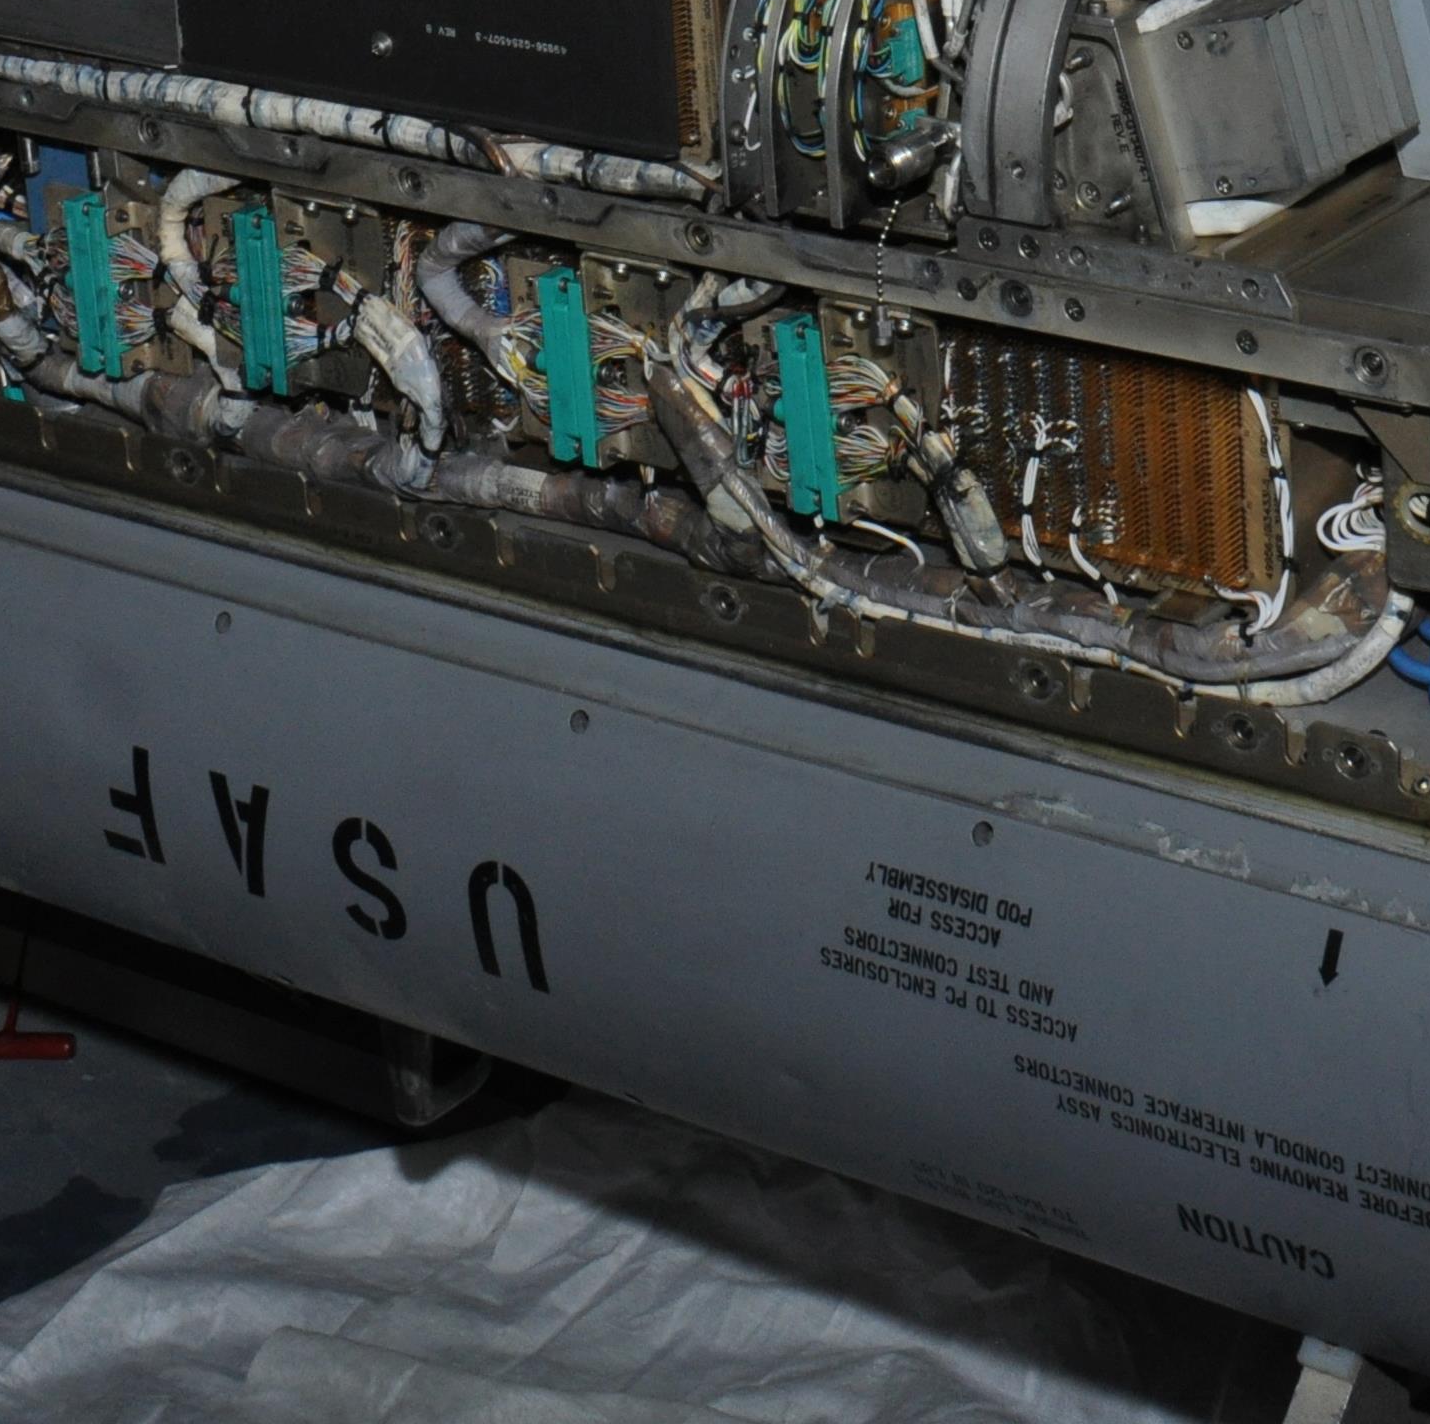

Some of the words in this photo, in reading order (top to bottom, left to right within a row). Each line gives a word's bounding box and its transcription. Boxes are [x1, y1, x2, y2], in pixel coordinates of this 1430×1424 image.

[864, 860, 989, 915] DISASSEMBLY
[886, 896, 922, 926] FOR
[930, 910, 1002, 949] ACCESS
[996, 899, 1033, 929] POD
[819, 946, 936, 999] ENCLOSURES
[843, 925, 958, 978] CONNECTORS
[945, 985, 968, 1010] PC
[966, 963, 1009, 995] TEST
[1018, 979, 1055, 1007] AND
[975, 995, 997, 1020] TO
[1006, 1004, 1078, 1043] ACCESS
[1013, 1053, 1134, 1108] CONNECTORS
[1055, 1093, 1102, 1124] ASSY
[1143, 1093, 1245, 1144] INTERFACE
[1110, 1109, 1241, 1168] ELECTRONICS
[1254, 1129, 1346, 1175] GONDOLA
[1249, 1155, 1349, 1204] REMOVING
[1176, 1202, 1336, 1281] CAUTION
